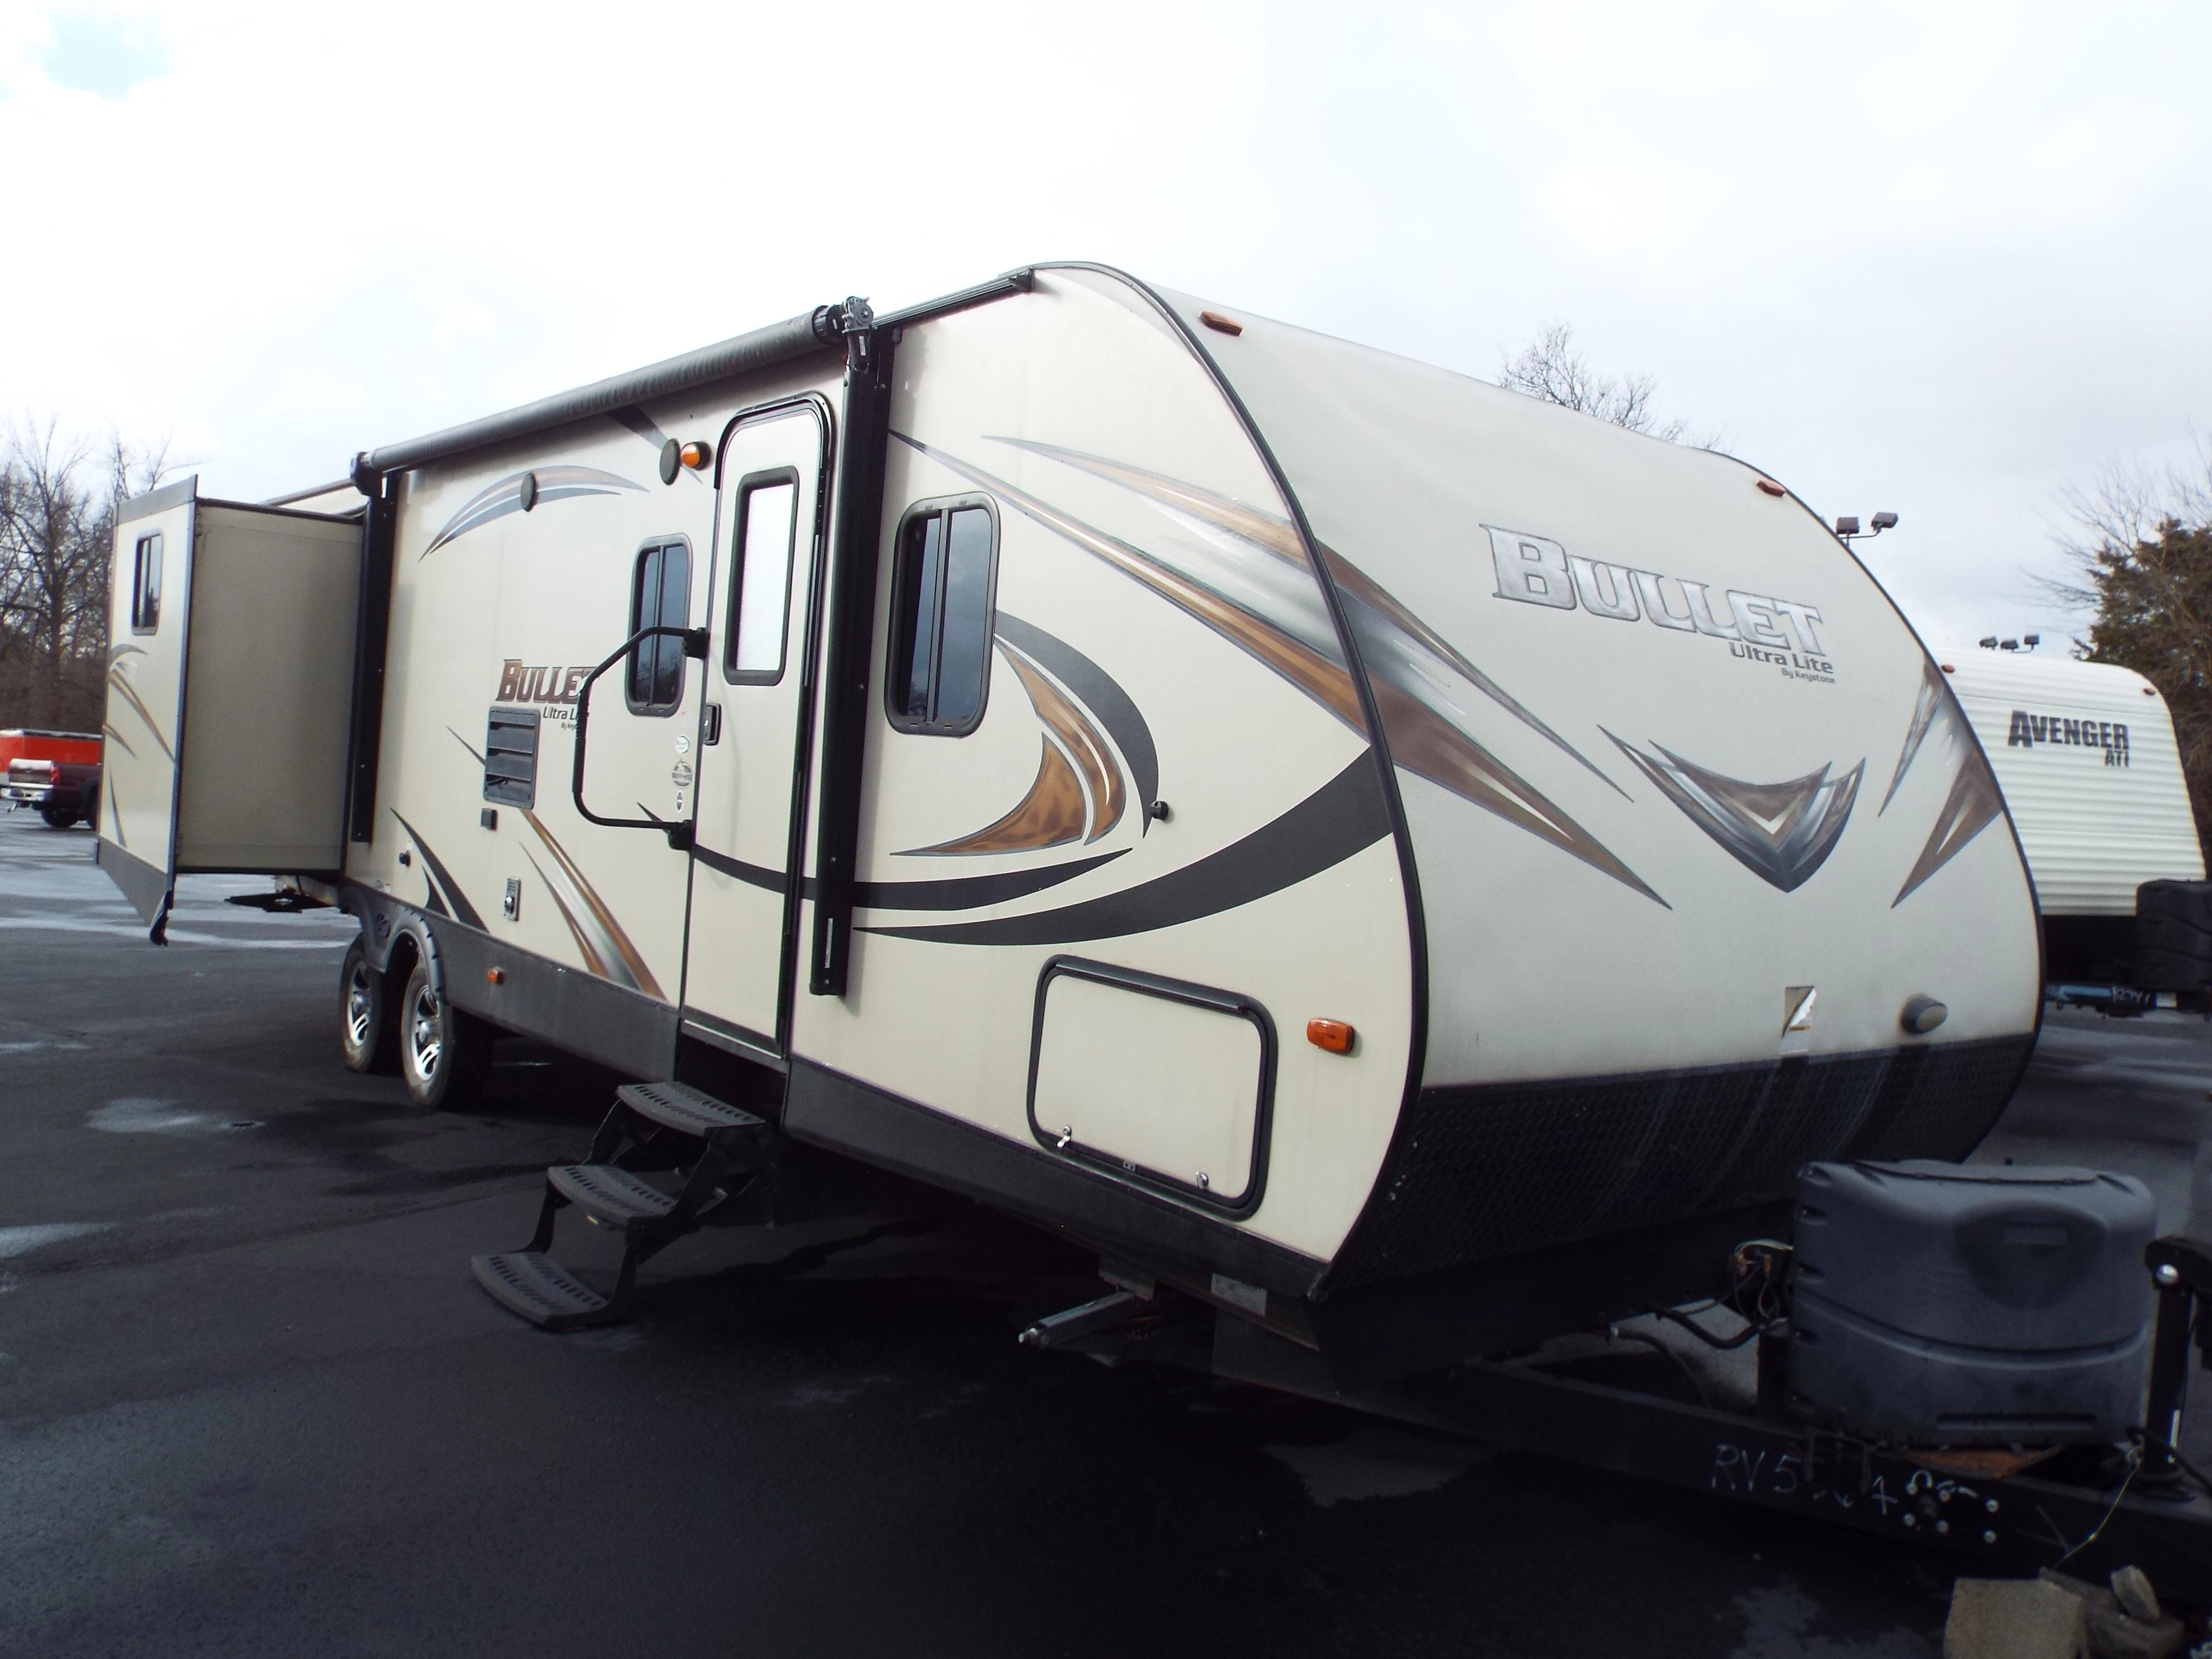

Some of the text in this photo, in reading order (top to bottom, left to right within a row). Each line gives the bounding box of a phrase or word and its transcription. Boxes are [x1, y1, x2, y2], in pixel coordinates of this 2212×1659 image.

[1479, 524, 1827, 656] BULLET
[1729, 642, 1834, 674] Ultra Lite
[1781, 668, 1793, 679] By
[542, 707, 568, 720] Ultra
[2008, 710, 2130, 750] AVENGER
[2104, 748, 2130, 768] ATI
